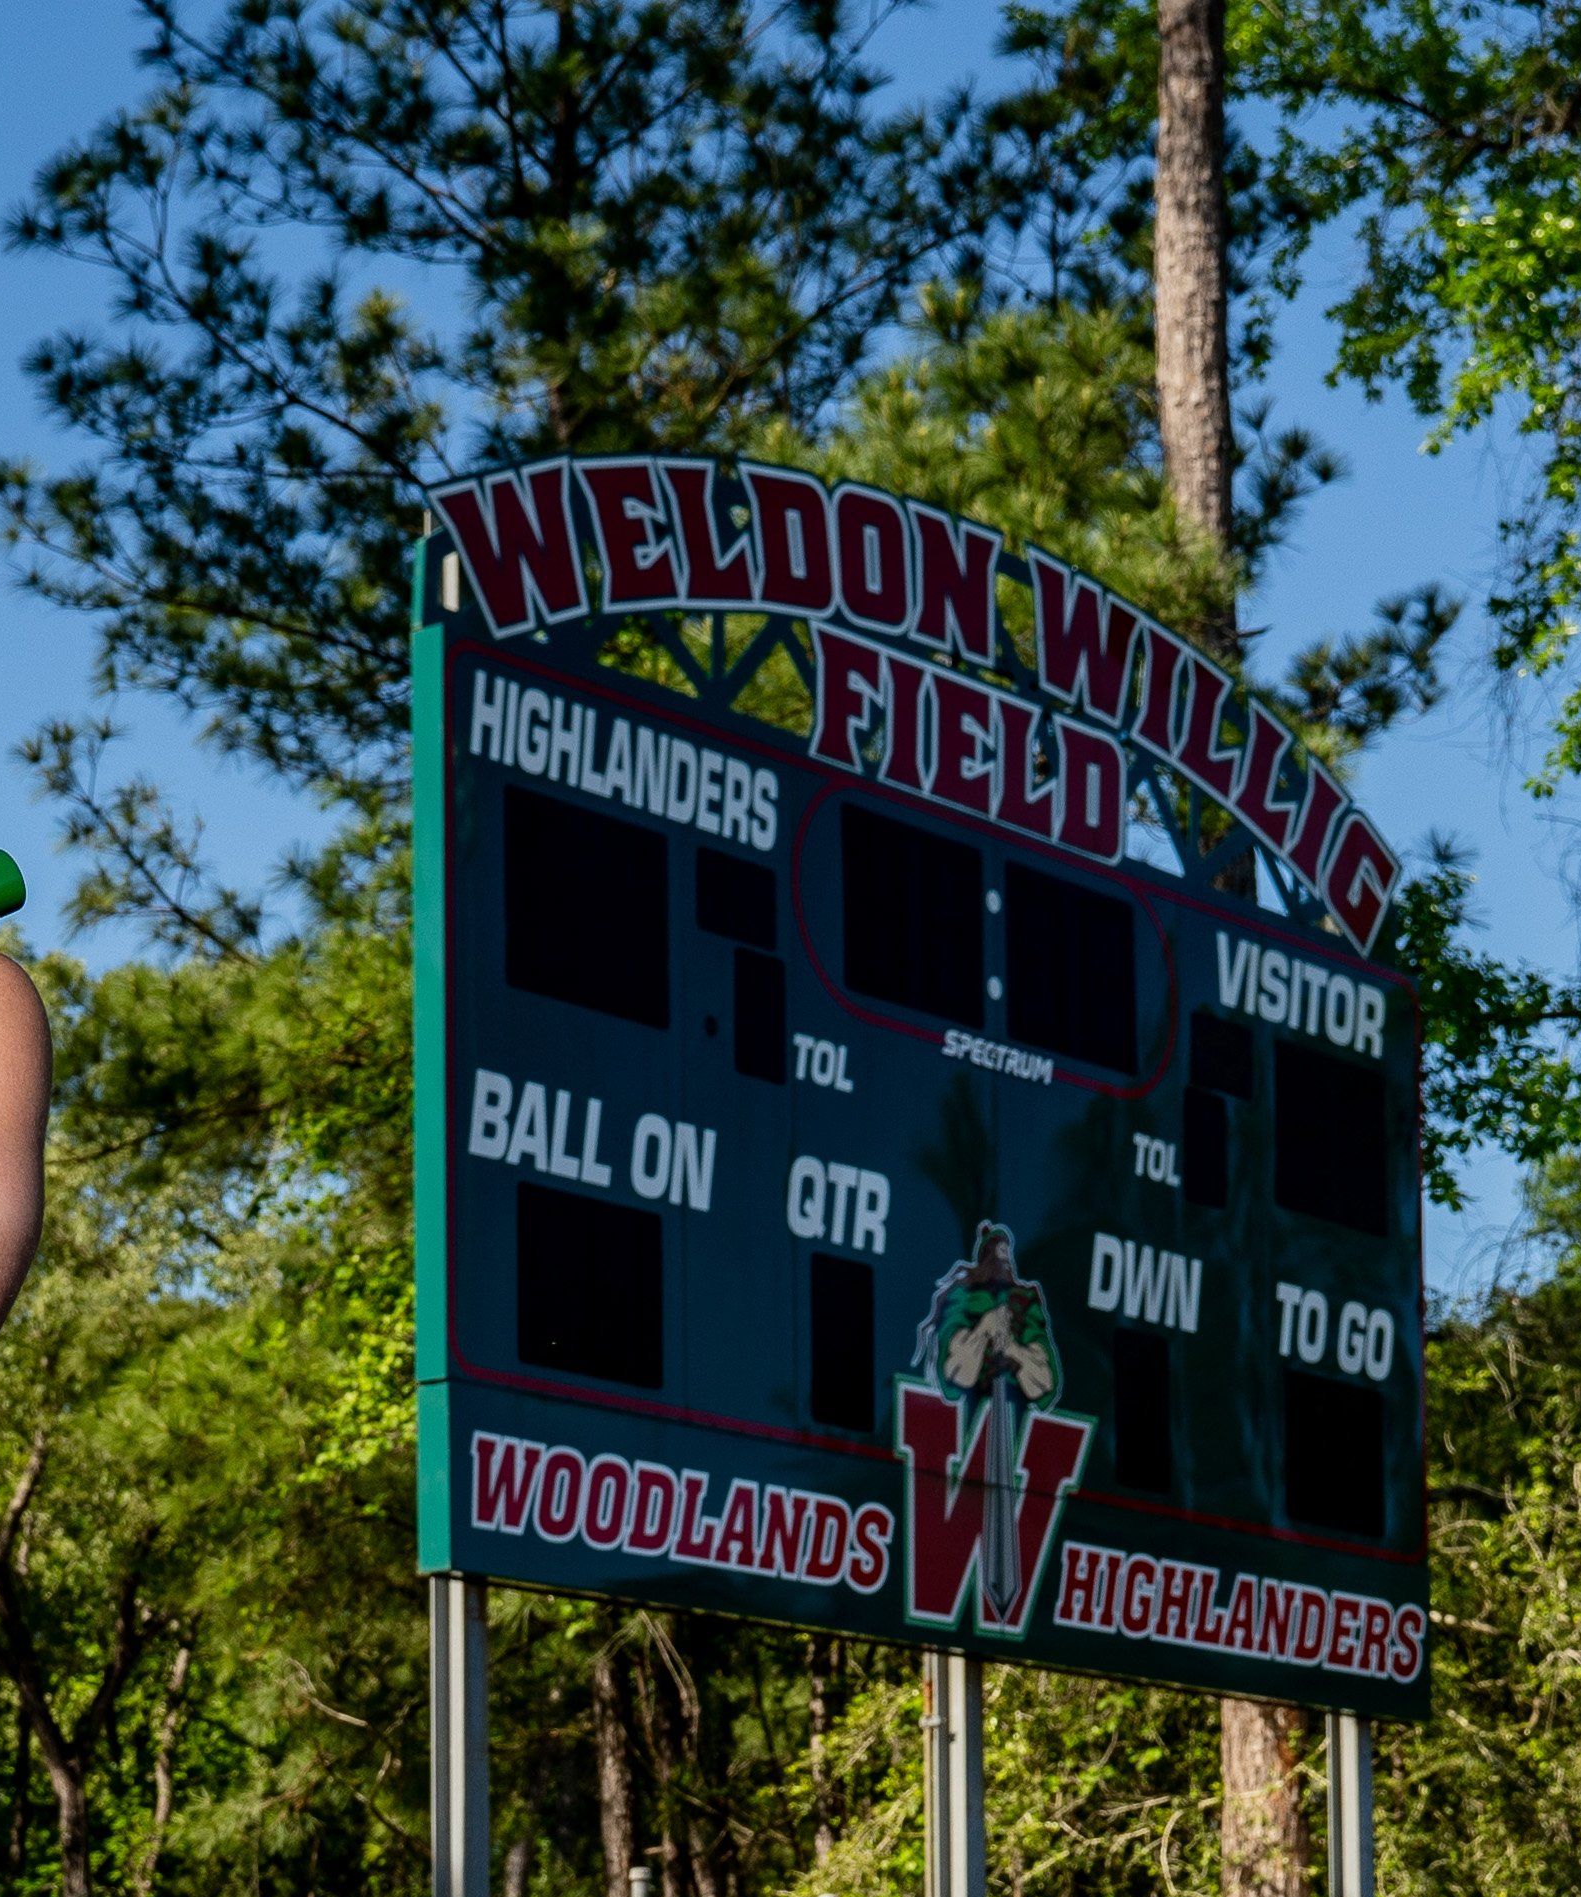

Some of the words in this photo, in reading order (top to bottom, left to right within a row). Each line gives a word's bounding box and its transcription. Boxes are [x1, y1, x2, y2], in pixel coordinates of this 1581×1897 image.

[426, 455, 1003, 668] WELDON
[1025, 540, 1401, 957] WILLIG
[469, 668, 779, 852] HIGHLANDERS
[809, 620, 1128, 866] FIELD
[941, 1029, 1054, 1086] SPECTRUM
[1216, 931, 1386, 1058] VISITOR
[792, 1032, 854, 1093] TOL
[468, 1068, 611, 1187] BALL
[629, 1113, 717, 1211] ON
[1132, 1132, 1181, 1188] TOL
[786, 1154, 891, 1255] QTR
[1087, 1231, 1203, 1334] DWN
[1275, 1281, 1329, 1361] TO
[1335, 1301, 1395, 1382] GO
[470, 1430, 895, 1595] WOODLANDS
[1054, 1540, 1425, 1686] HIGHLANDERS
